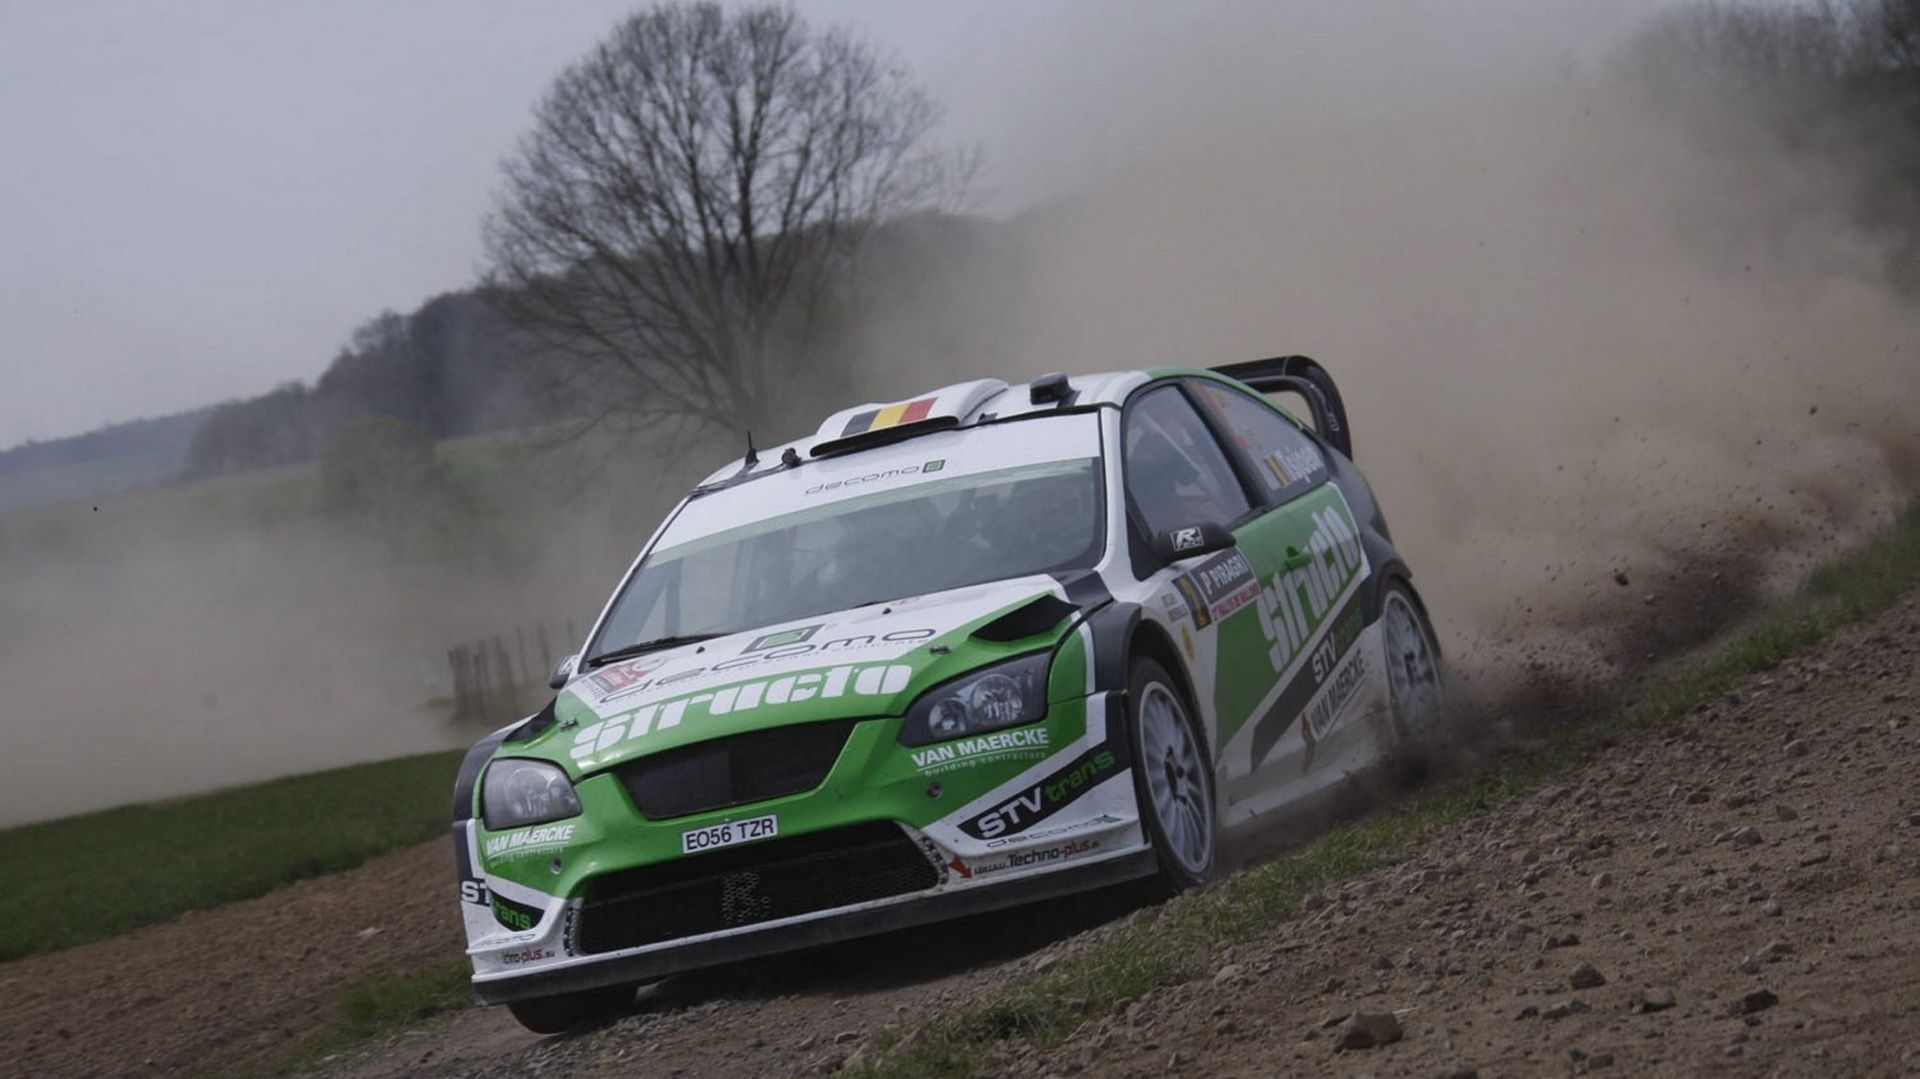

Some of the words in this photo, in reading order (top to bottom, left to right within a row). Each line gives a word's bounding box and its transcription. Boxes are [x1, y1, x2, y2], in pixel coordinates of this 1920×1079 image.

[805, 466, 920, 495] decomo
[1312, 630, 1337, 683] STV
[911, 745, 955, 767] VAN
[957, 728, 1050, 756] MAERCKE
[978, 787, 1043, 839] STV
[1045, 751, 1115, 801] trans
[486, 835, 510, 856] VAN
[509, 825, 575, 850] MAERCKE
[686, 825, 732, 850] EO56
[738, 818, 775, 839] TZR
